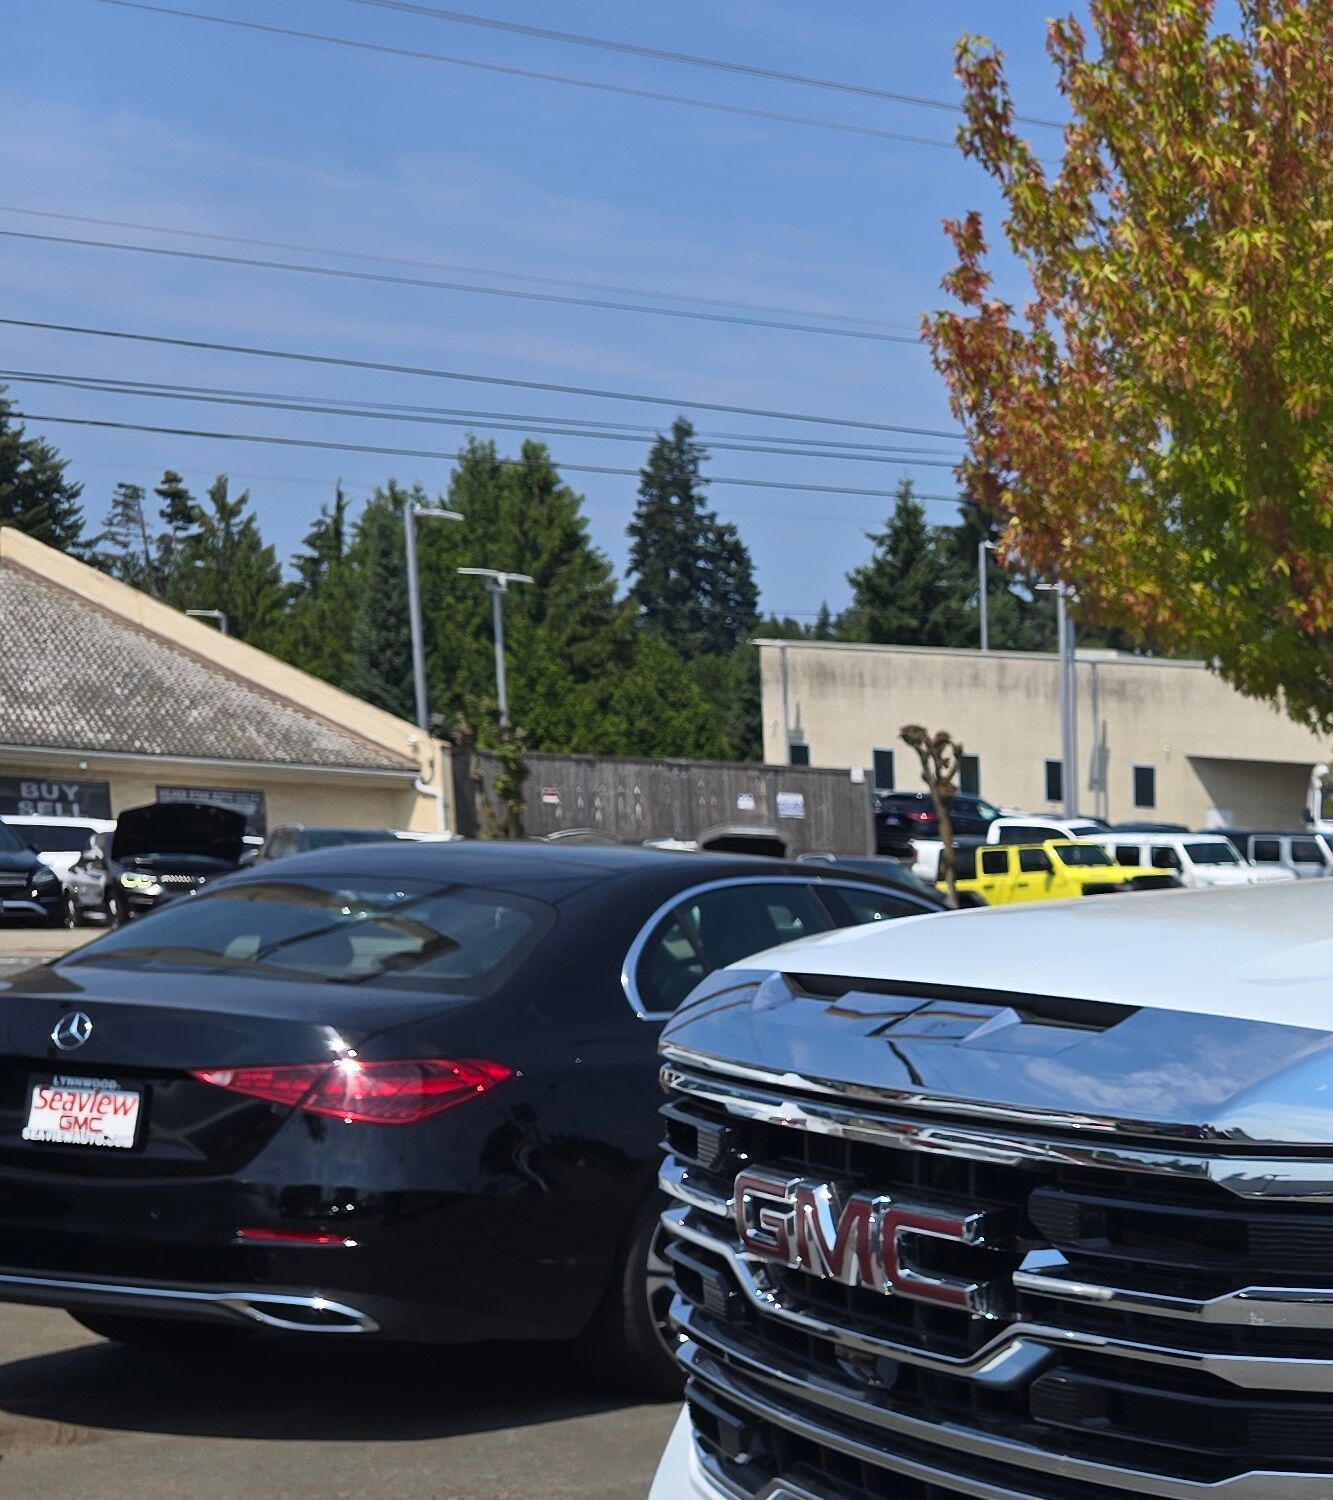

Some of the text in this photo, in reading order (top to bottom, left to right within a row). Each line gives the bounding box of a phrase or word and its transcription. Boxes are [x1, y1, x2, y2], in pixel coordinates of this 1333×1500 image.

[20, 782, 79, 802] BUY
[35, 1085, 138, 1116] Seaview
[59, 1115, 103, 1132] GMC
[735, 1165, 990, 1318] GMC
